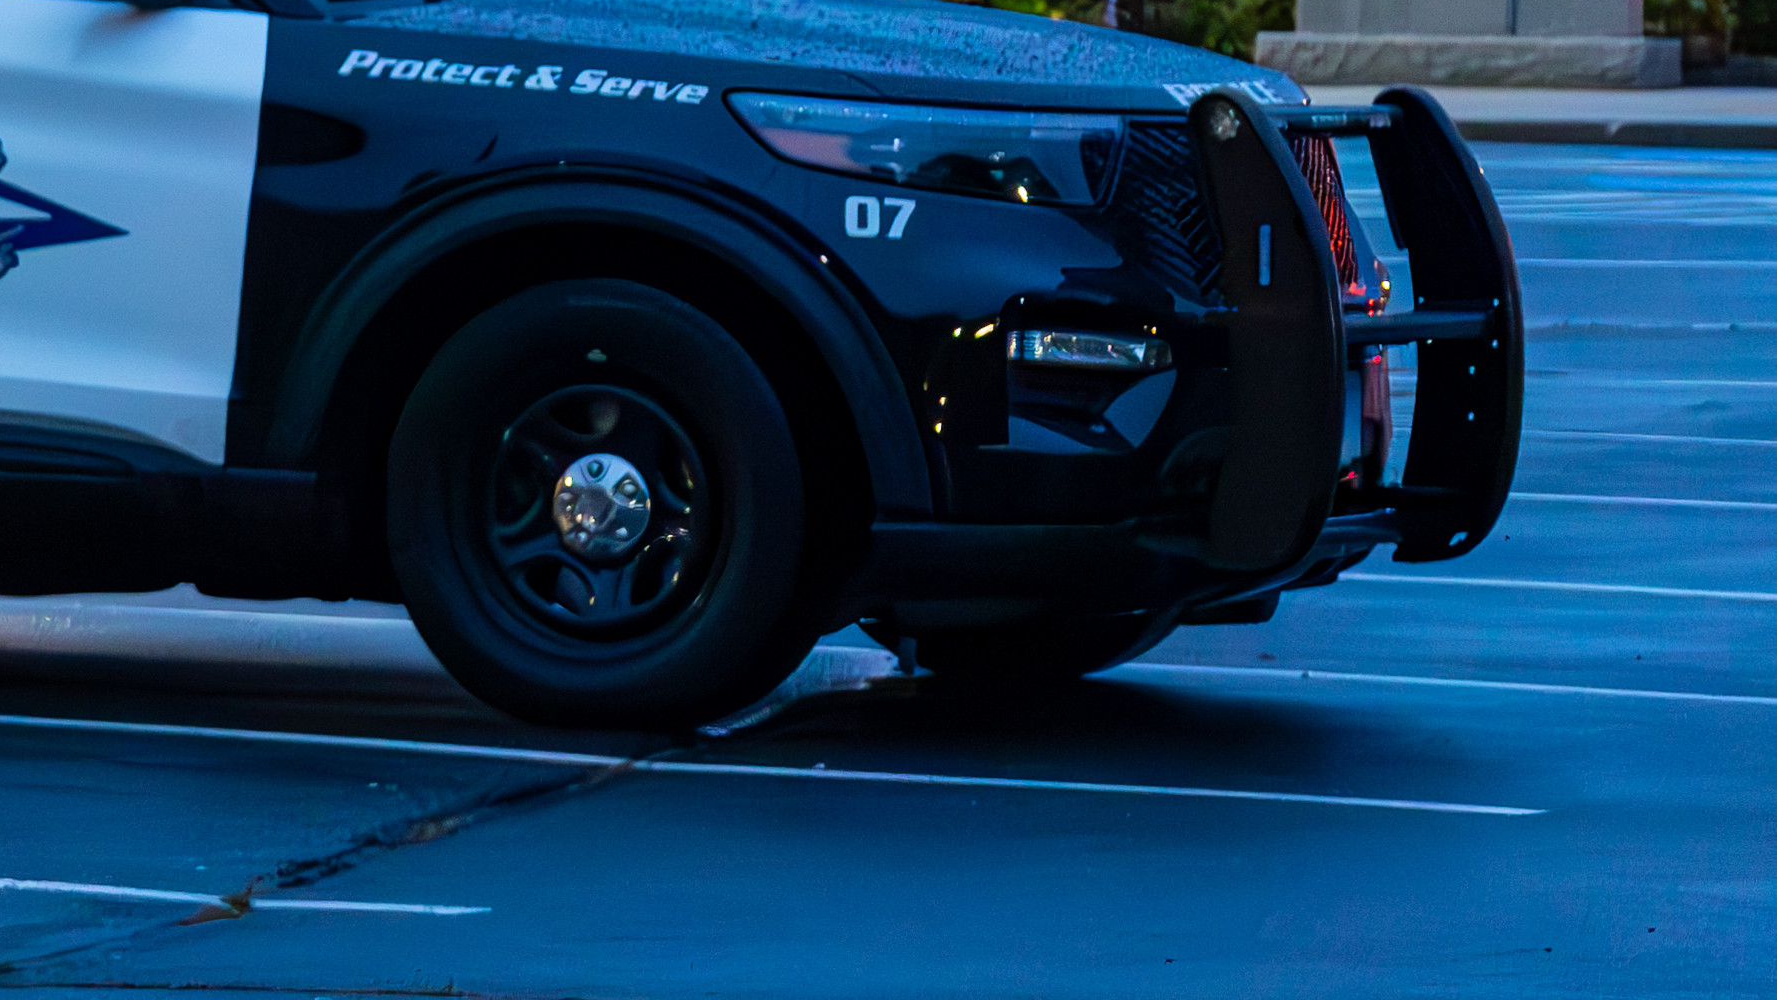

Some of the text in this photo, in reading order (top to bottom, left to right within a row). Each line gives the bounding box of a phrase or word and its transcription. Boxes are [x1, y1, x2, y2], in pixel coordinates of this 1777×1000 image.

[338, 48, 711, 105] Protect & Serve
[845, 195, 917, 240] 07
